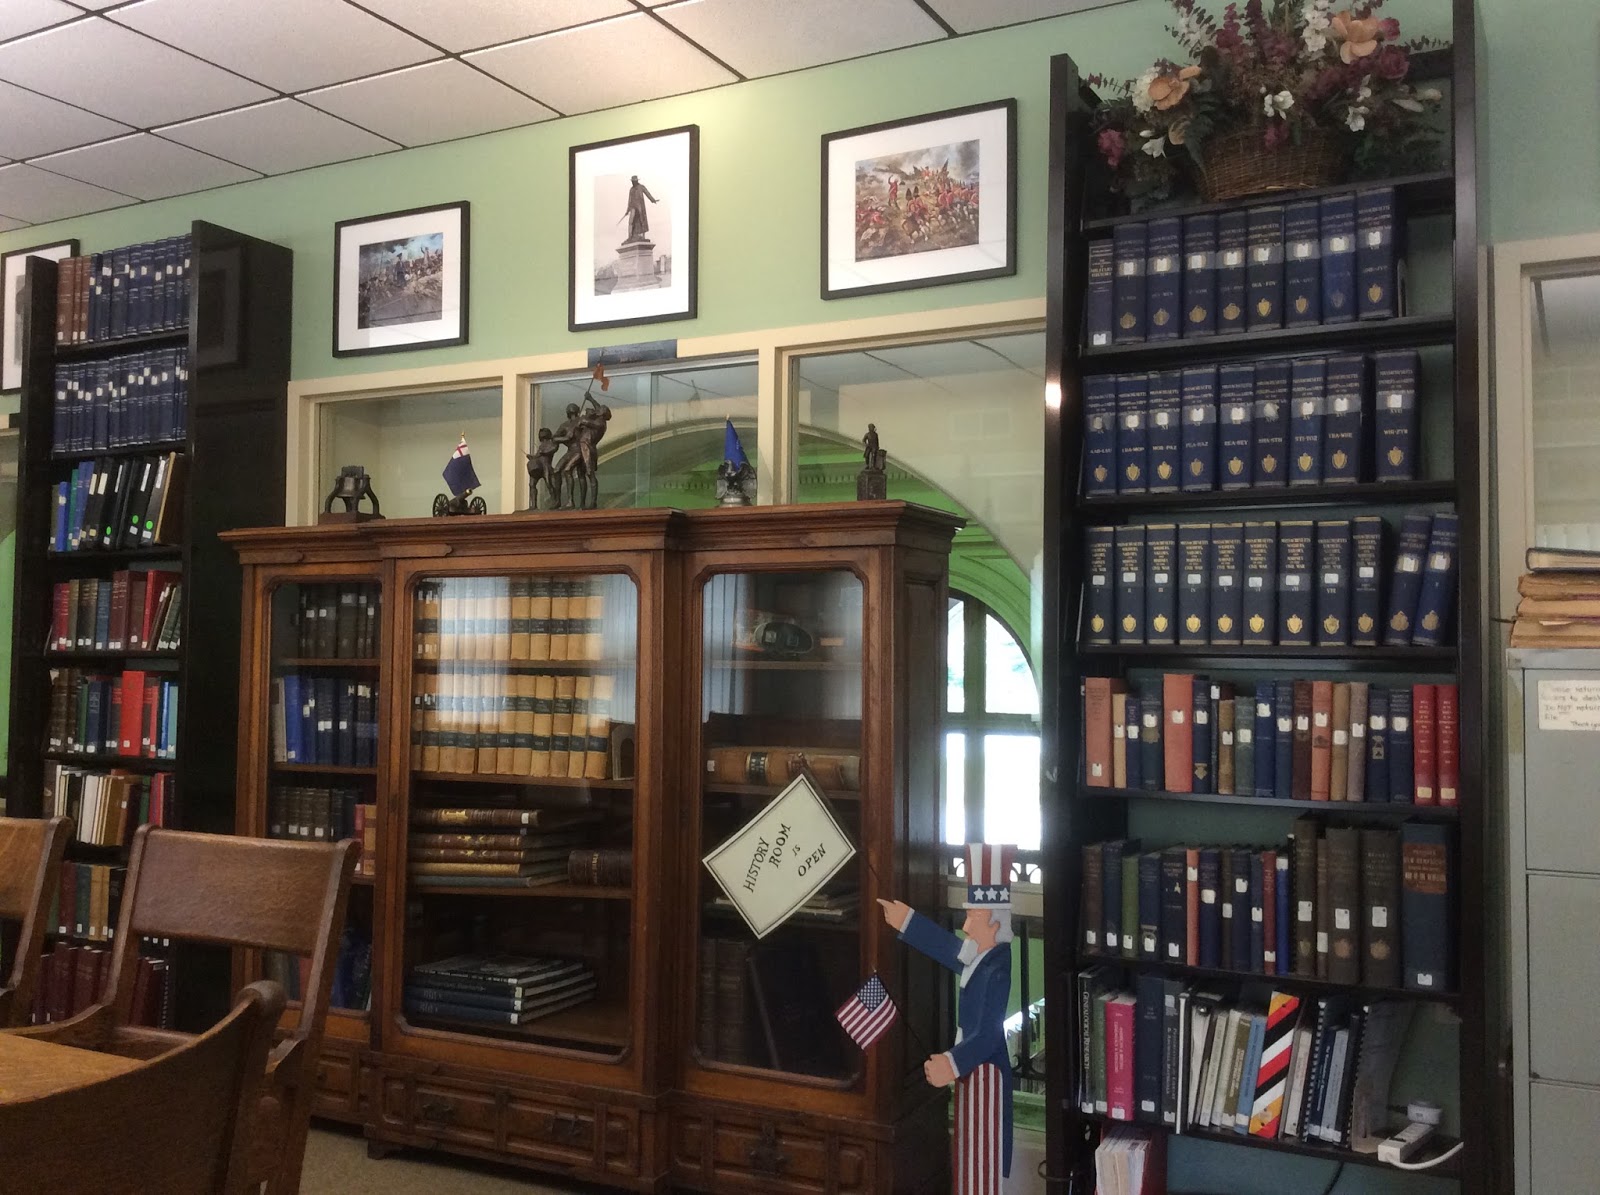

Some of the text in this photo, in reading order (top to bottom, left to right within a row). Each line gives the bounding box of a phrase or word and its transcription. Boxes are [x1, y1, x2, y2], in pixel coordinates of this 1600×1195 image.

[743, 836, 769, 893] HISTORY
[769, 823, 791, 869] ROOM
[792, 844, 801, 857] IS
[798, 843, 826, 876] OPEN
